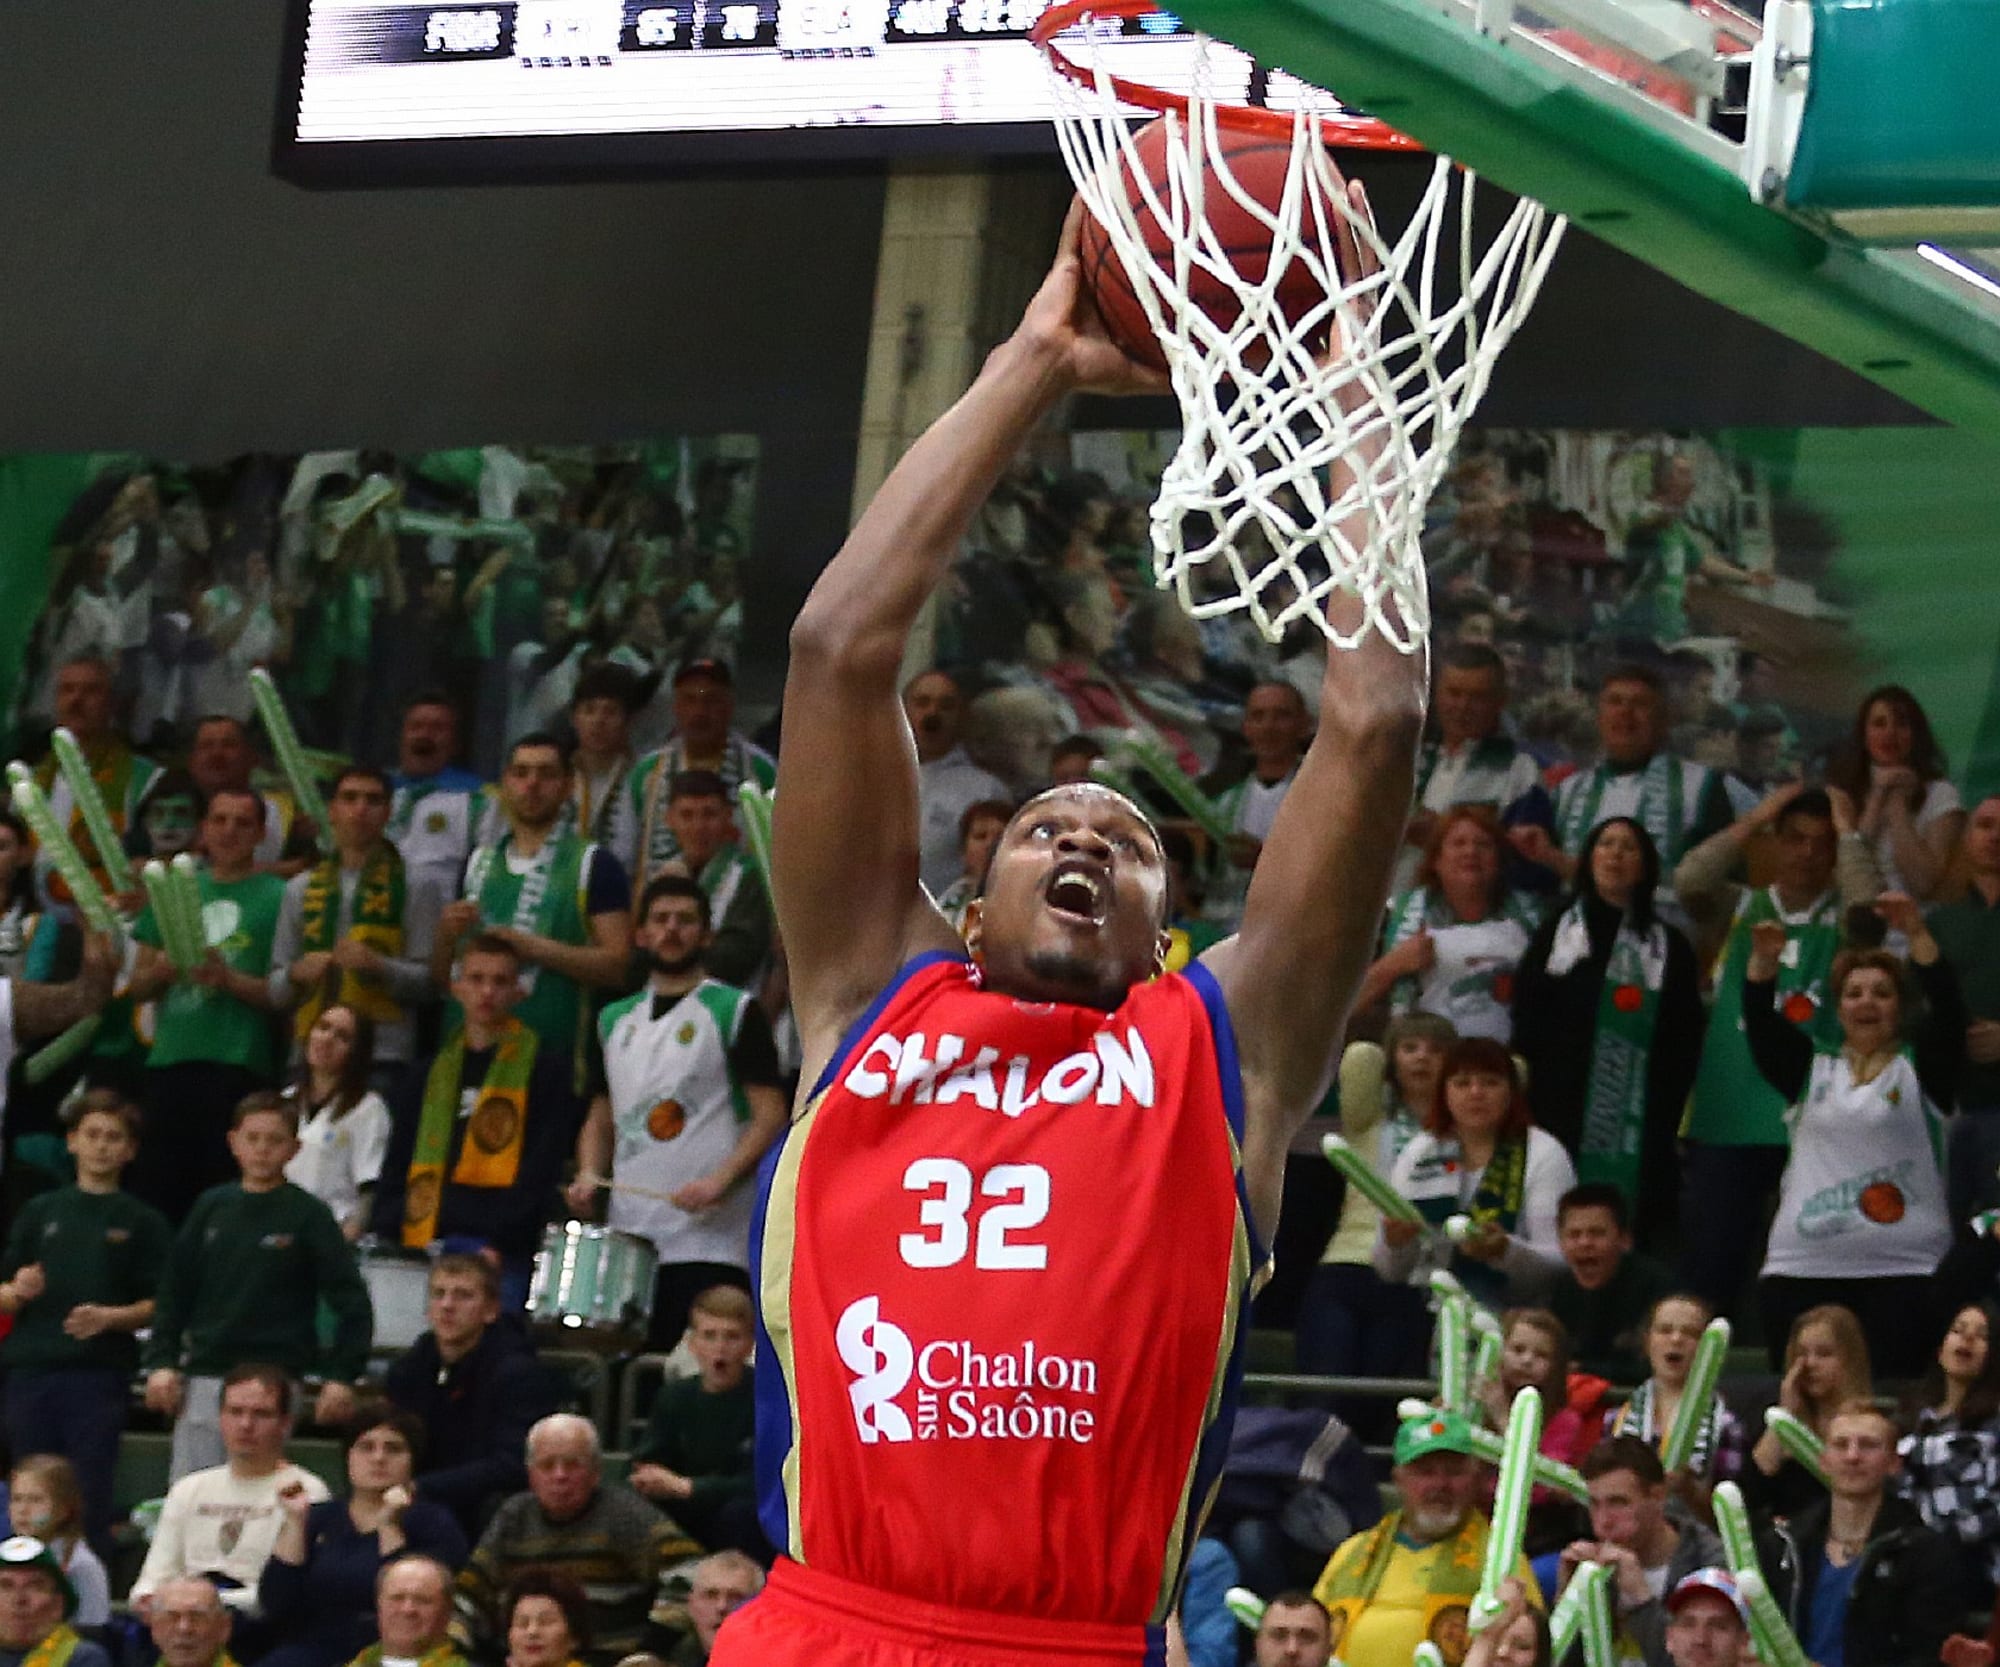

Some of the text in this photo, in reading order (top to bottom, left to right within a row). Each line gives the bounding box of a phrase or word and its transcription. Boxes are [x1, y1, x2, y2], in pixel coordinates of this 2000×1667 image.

[845, 1026, 1154, 1117] CHALON
[900, 1158, 1050, 1269] 32
[917, 1340, 1097, 1394] Chalon
[917, 1386, 940, 1441] sur
[946, 1390, 1095, 1443] Saône
